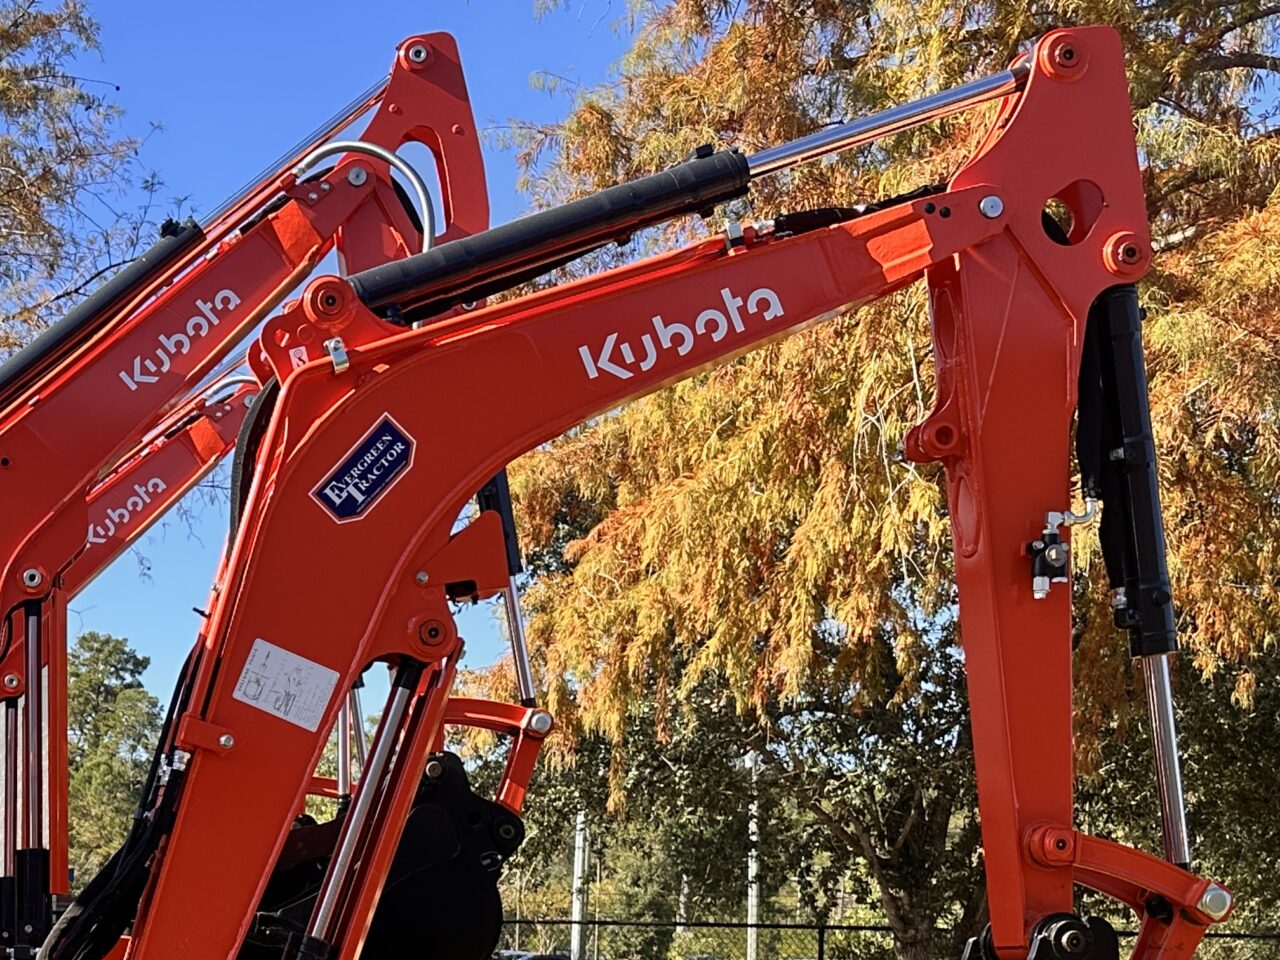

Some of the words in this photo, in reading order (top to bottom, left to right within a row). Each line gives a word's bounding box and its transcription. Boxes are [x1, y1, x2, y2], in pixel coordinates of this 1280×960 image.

[119, 289, 241, 391] Kubota
[579, 288, 785, 379] Kubota
[322, 433, 393, 507] EVERGREEN
[346, 441, 406, 505] TRACTOR
